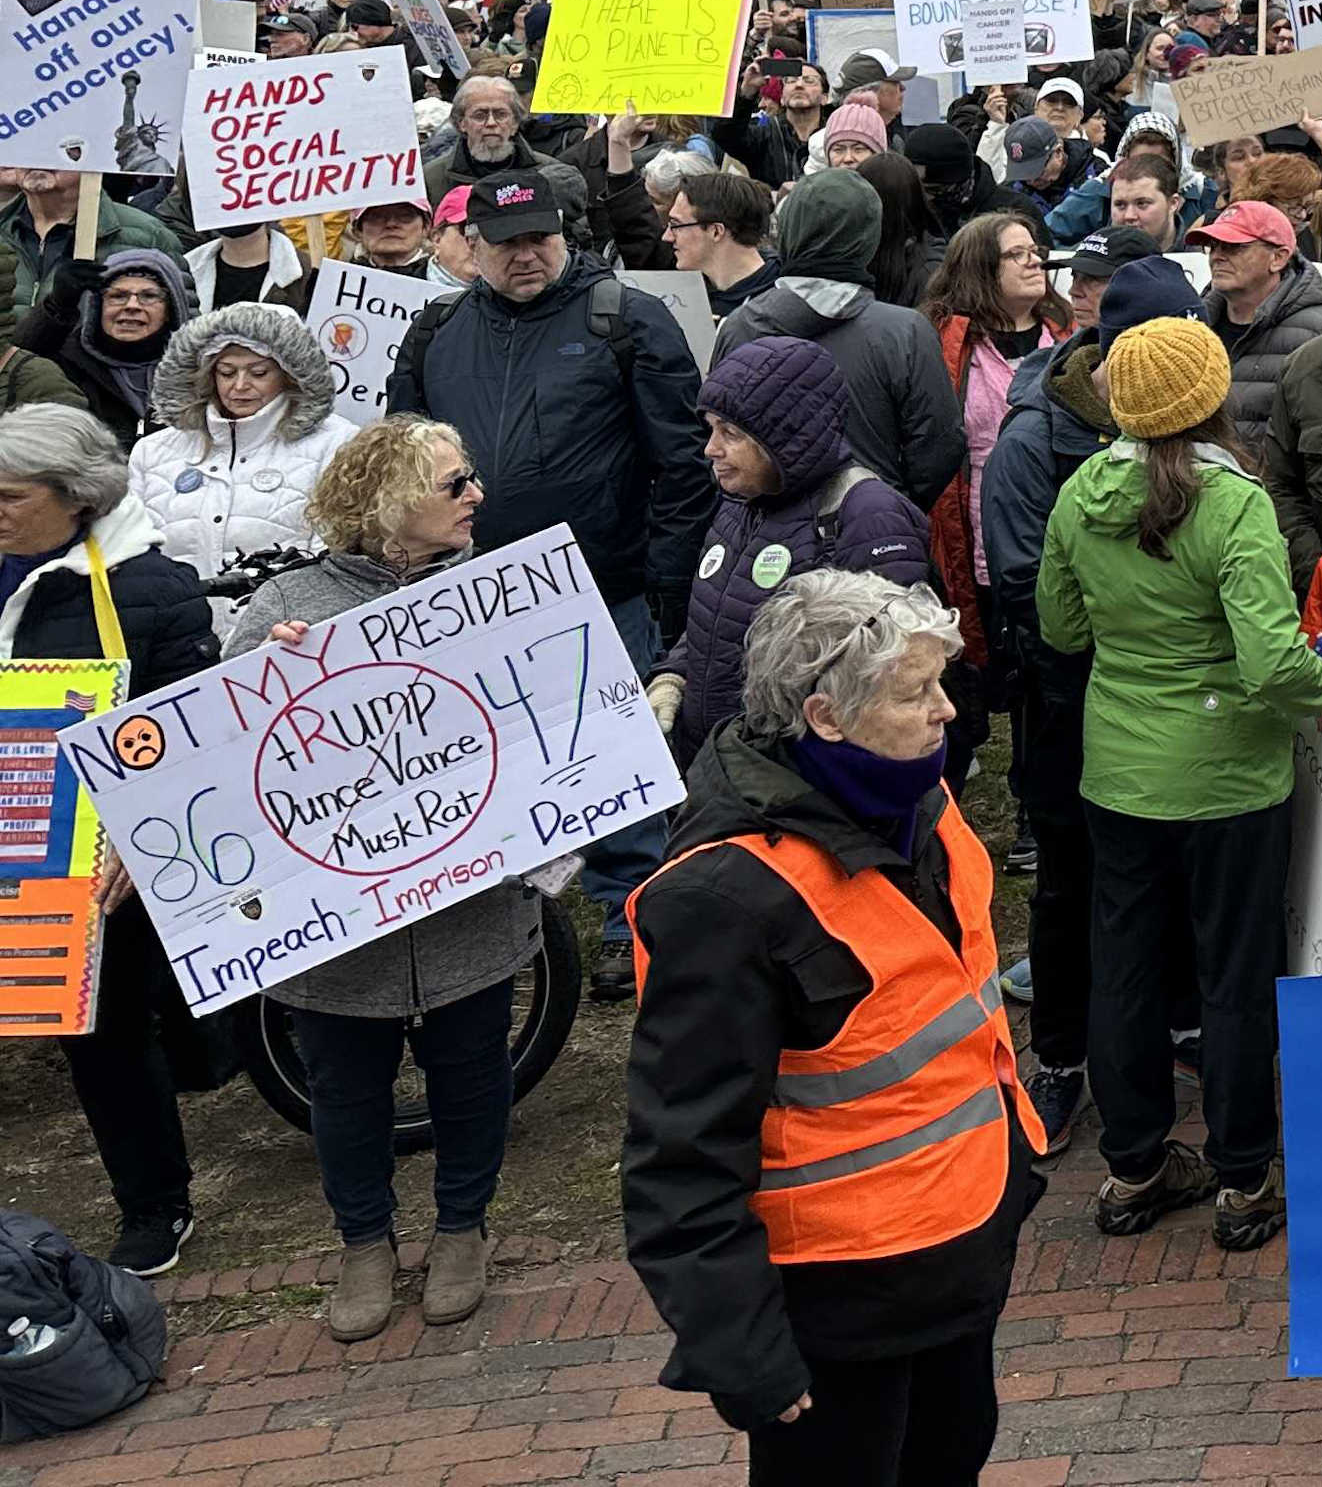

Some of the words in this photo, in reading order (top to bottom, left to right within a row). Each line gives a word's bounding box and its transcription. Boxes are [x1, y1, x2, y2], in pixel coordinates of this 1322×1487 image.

[34, 42, 77, 83] off
[89, 5, 145, 49] our
[550, 33, 591, 63] NO
[695, 36, 721, 64] B
[203, 72, 335, 114] HANDS
[1178, 72, 1216, 101] BIG
[1215, 64, 1277, 91] BOOTY
[211, 110, 287, 144] OFF
[215, 128, 347, 175] SOCIAL
[220, 147, 418, 212] SECURITY!
[221, 624, 338, 732] MY
[359, 539, 584, 662] PRESIDENT
[474, 621, 591, 767] 47
[597, 676, 642, 711] NOW
[263, 773, 376, 839] Dunce
[365, 733, 485, 790] Vance
[129, 785, 257, 904] 86
[332, 815, 421, 869] Musk
[418, 787, 482, 842] Rat
[169, 900, 347, 1006] Impeach
[359, 849, 505, 929] Imprison
[527, 773, 657, 848] Deport
